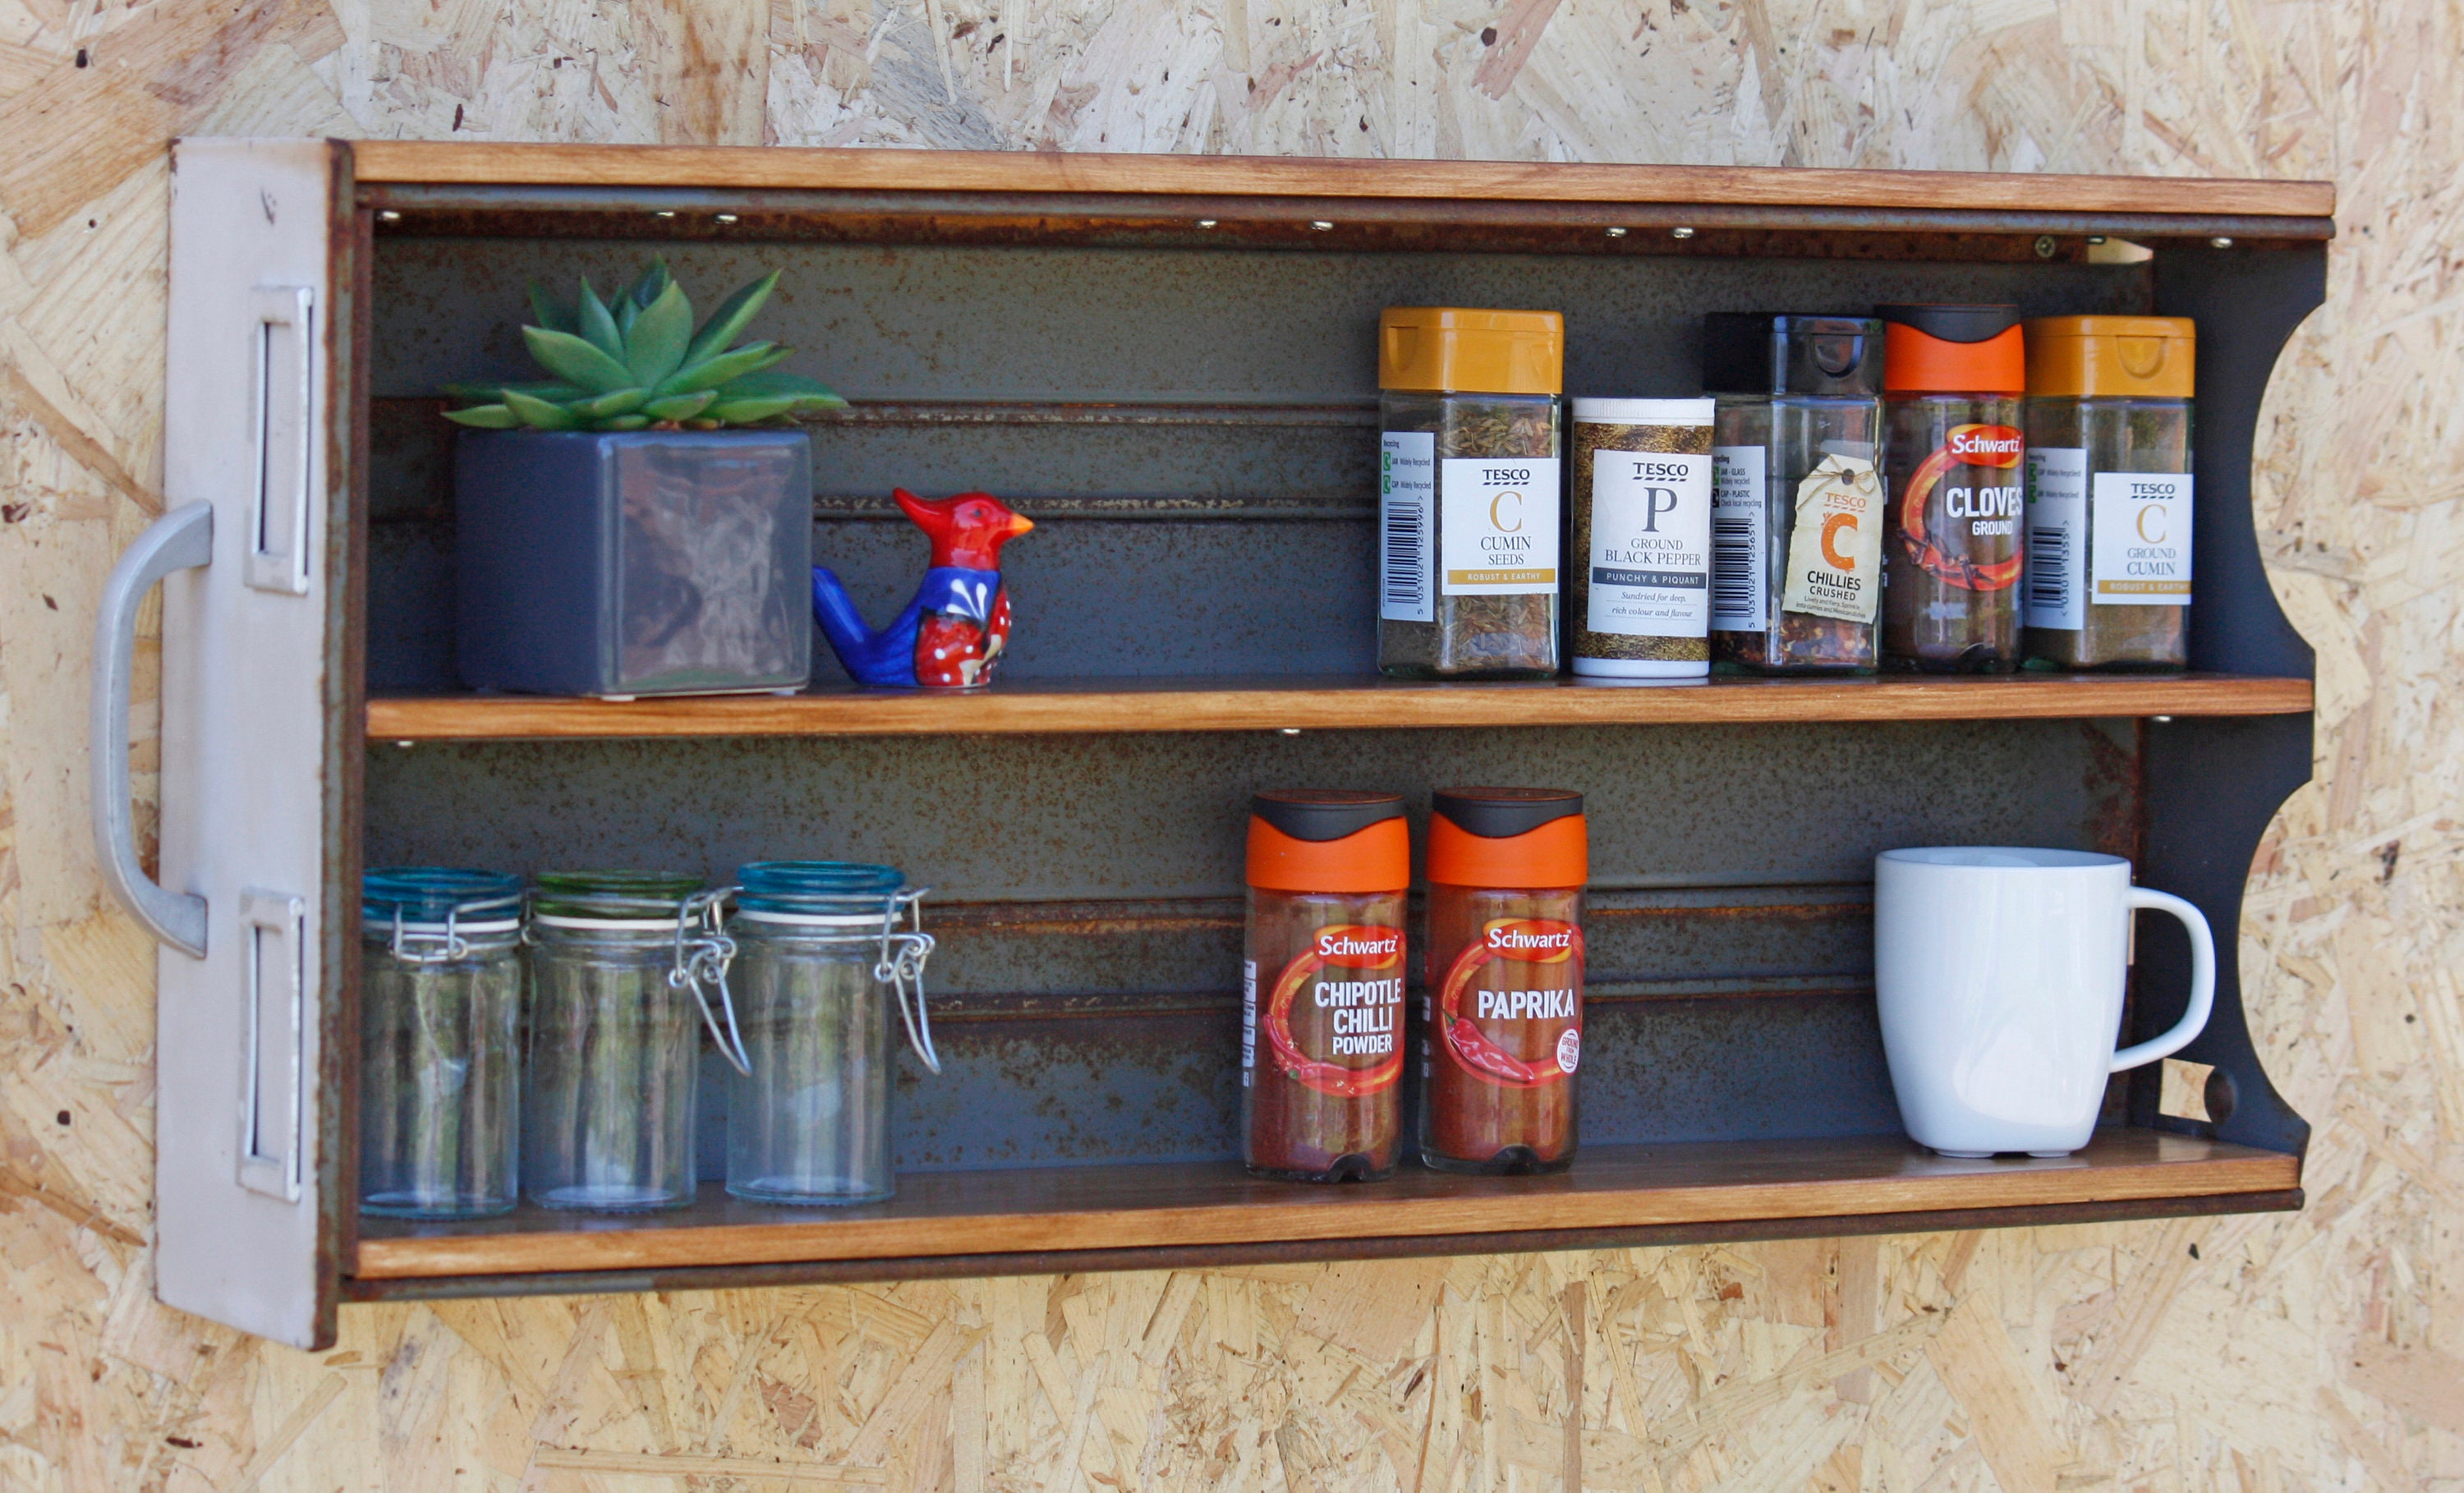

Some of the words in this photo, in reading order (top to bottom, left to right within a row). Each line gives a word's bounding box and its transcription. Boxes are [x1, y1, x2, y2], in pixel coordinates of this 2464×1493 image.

[1951, 434, 2020, 453] Schwartz
[1483, 469, 1530, 480] TESCO
[1633, 462, 1689, 476] TESCO
[2131, 483, 2175, 494] TESCO
[1825, 493, 1866, 508] TESCO
[1947, 487, 2023, 517] CLOVES
[1490, 491, 1522, 532] C
[1641, 487, 1677, 532] P
[1972, 521, 2012, 535] GROUND
[2136, 503, 2167, 544] C
[1481, 536, 1531, 550] CUMIN
[1630, 538, 1683, 550] GROUND
[1821, 512, 1858, 571] C
[1488, 554, 1524, 565] SEEDS
[1605, 549, 1653, 564] BLACK
[1657, 553, 1701, 566] PEPPER
[2127, 548, 2176, 559] GROUND
[2126, 562, 2176, 575] CUMIN
[1511, 572, 1541, 581] EARTHY
[1607, 572, 1647, 582] PUNCHY
[1662, 576, 1699, 584] PIQUANT
[1807, 571, 1861, 591] CHILLIES
[1621, 591, 1656, 600] Sundried
[1657, 593, 1668, 602] for
[1809, 586, 1856, 601] CRUSHED
[1629, 608, 1653, 616] colour
[1655, 609, 1669, 617] and
[1670, 610, 1693, 618] flavour
[1318, 935, 1396, 956] Schwartz
[1487, 927, 1570, 949] Schwartz
[1315, 977, 1401, 1008] CHIPOTLE
[1478, 989, 1574, 1019] PAPRIKA
[1333, 1006, 1393, 1034] CHILLI
[1332, 1033, 1392, 1055] POWDER
[1561, 1052, 1576, 1064] WHOLE
